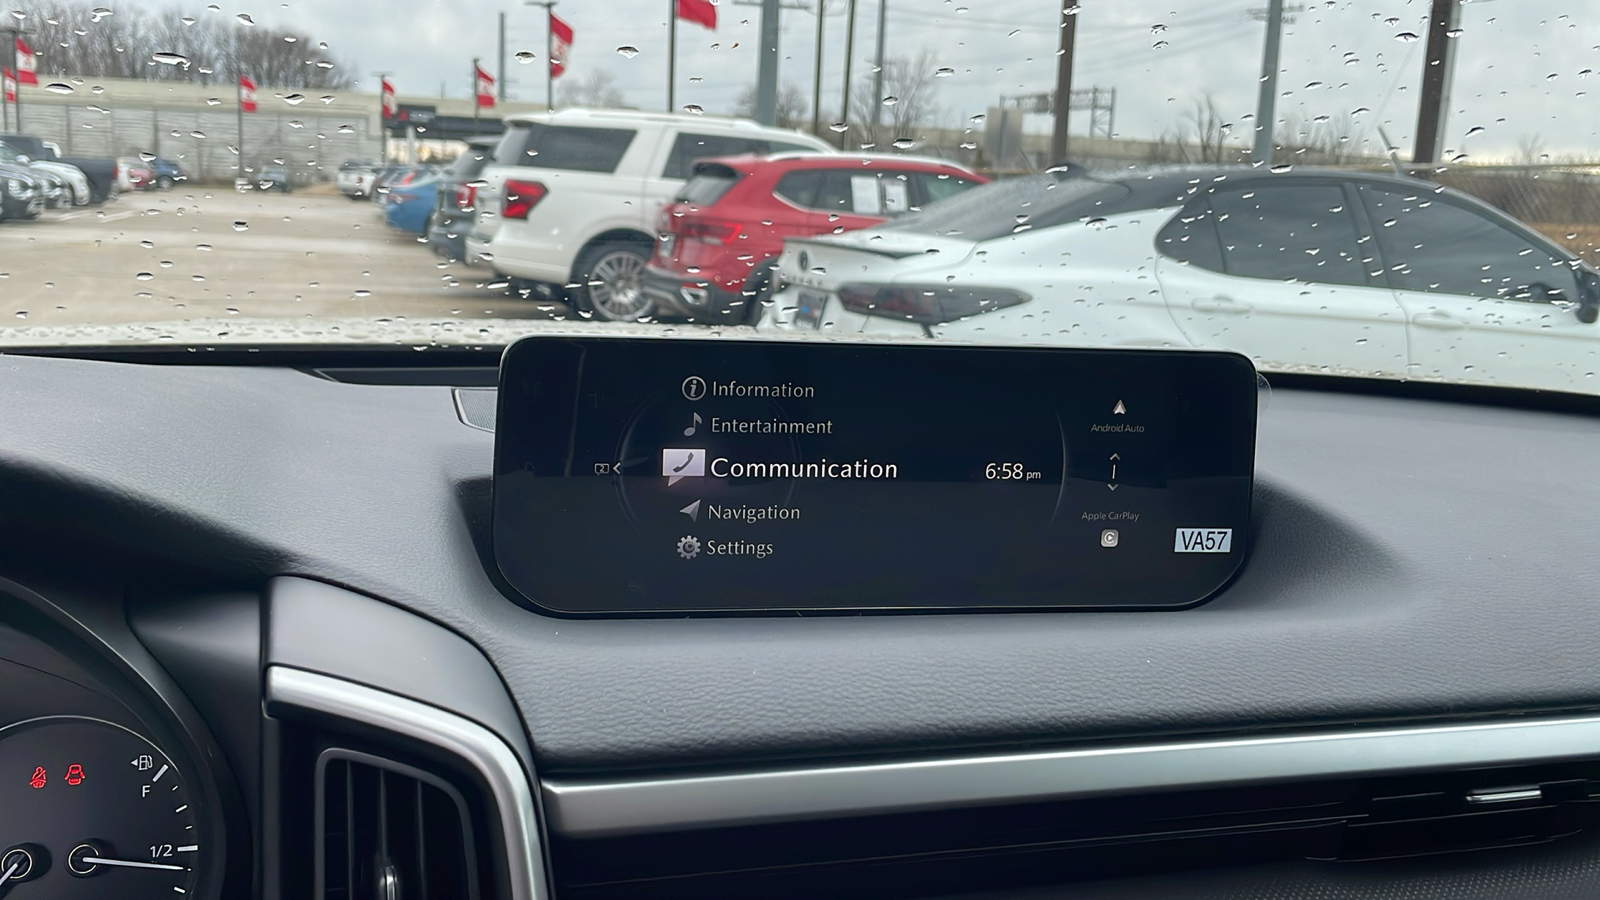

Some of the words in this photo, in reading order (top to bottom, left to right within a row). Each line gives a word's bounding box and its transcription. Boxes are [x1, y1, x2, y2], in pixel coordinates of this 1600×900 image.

[712, 380, 815, 398] Information
[711, 417, 833, 434] Entertainment
[1090, 423, 1124, 433] Android
[1125, 424, 1145, 433] Auto
[710, 457, 898, 479] Communication
[985, 462, 1024, 480] 6:58
[1026, 471, 1042, 481] pm
[708, 504, 800, 524] Navigation
[1081, 511, 1107, 521] Apple
[1108, 511, 1140, 522] CarPlay
[706, 539, 774, 559] Settings
[1181, 531, 1228, 551] VA57
[142, 785, 151, 798] F
[149, 844, 173, 858] 1/2
